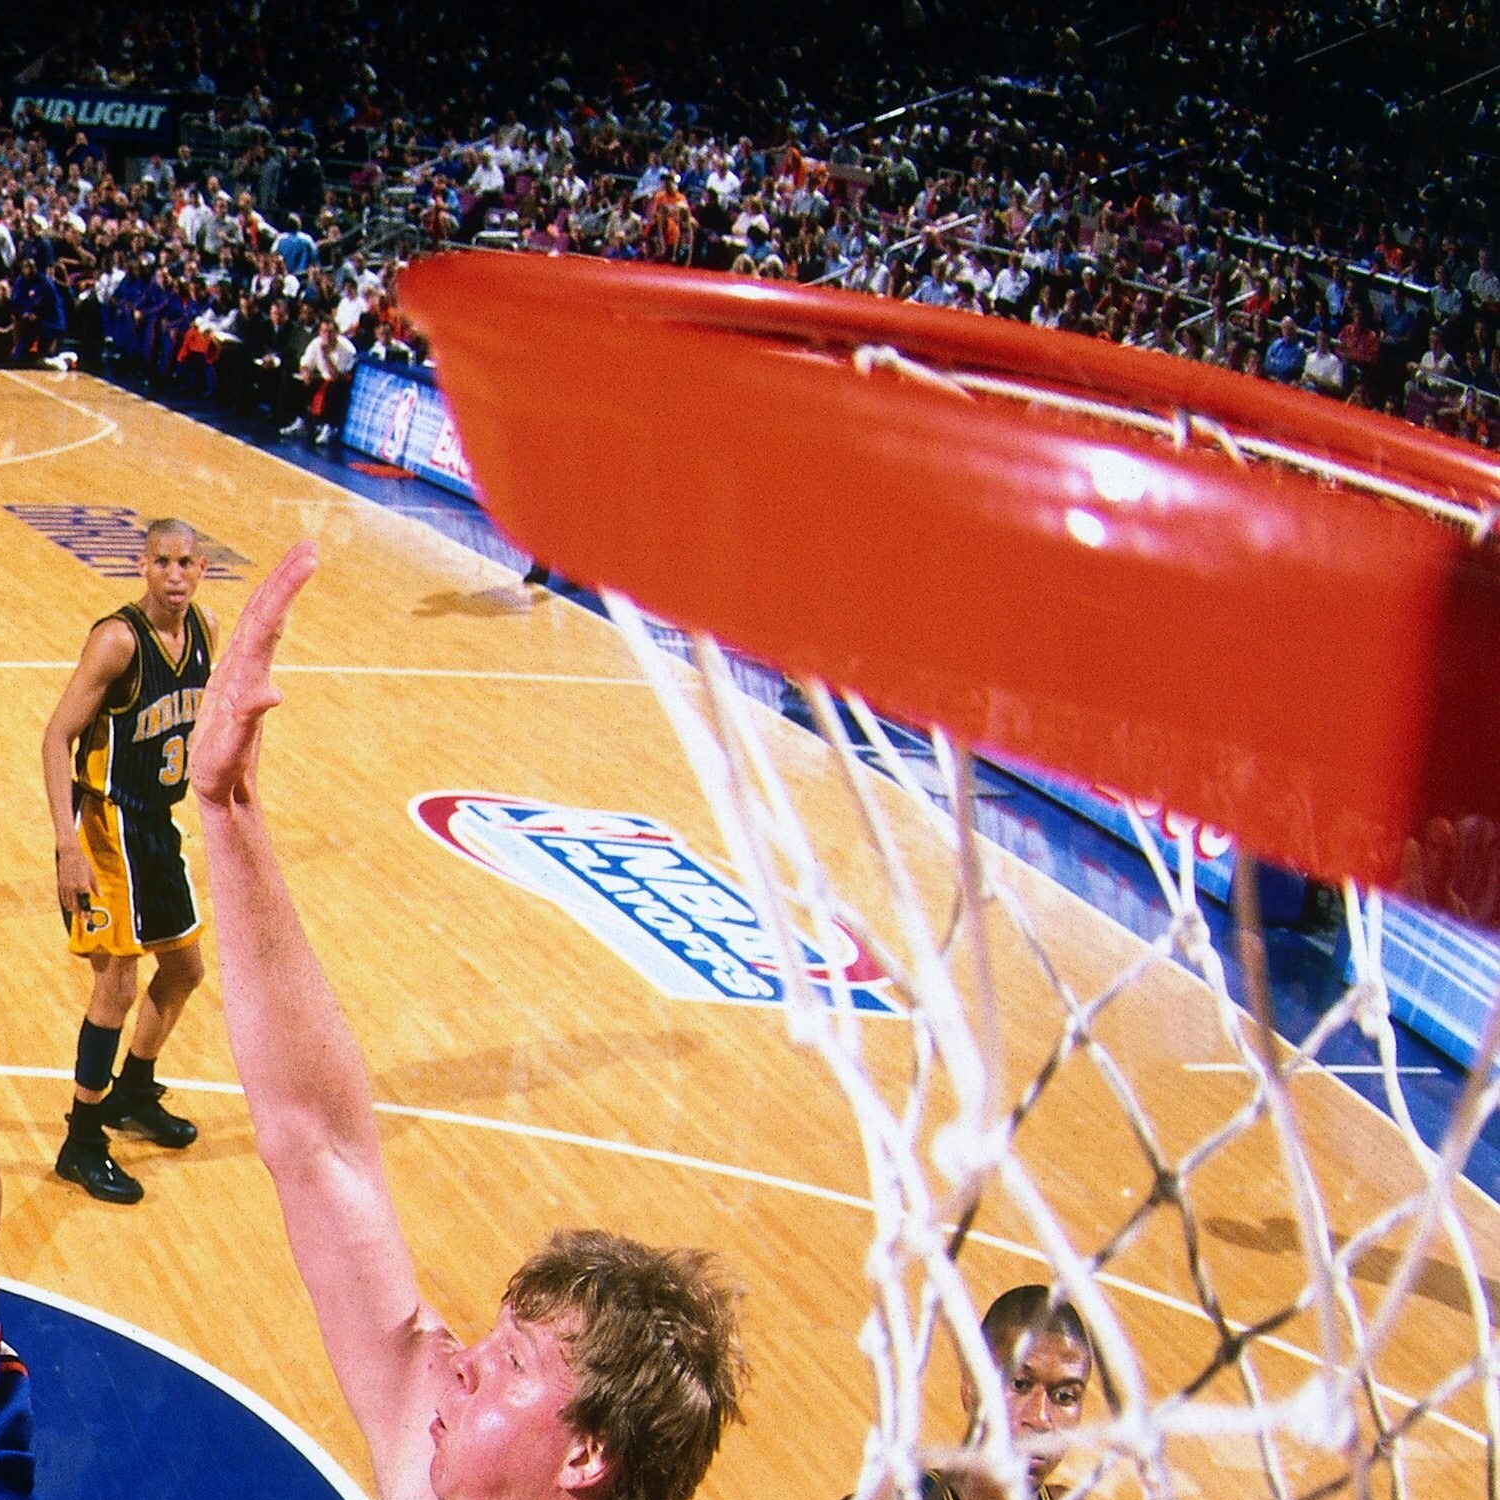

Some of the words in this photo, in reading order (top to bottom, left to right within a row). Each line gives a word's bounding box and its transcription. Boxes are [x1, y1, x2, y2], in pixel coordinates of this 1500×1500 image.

[76, 100, 168, 131] LIGHT
[132, 687, 206, 743] INDIA
[542, 837, 776, 999] PLAYOFFS
[604, 841, 776, 961] NBA
